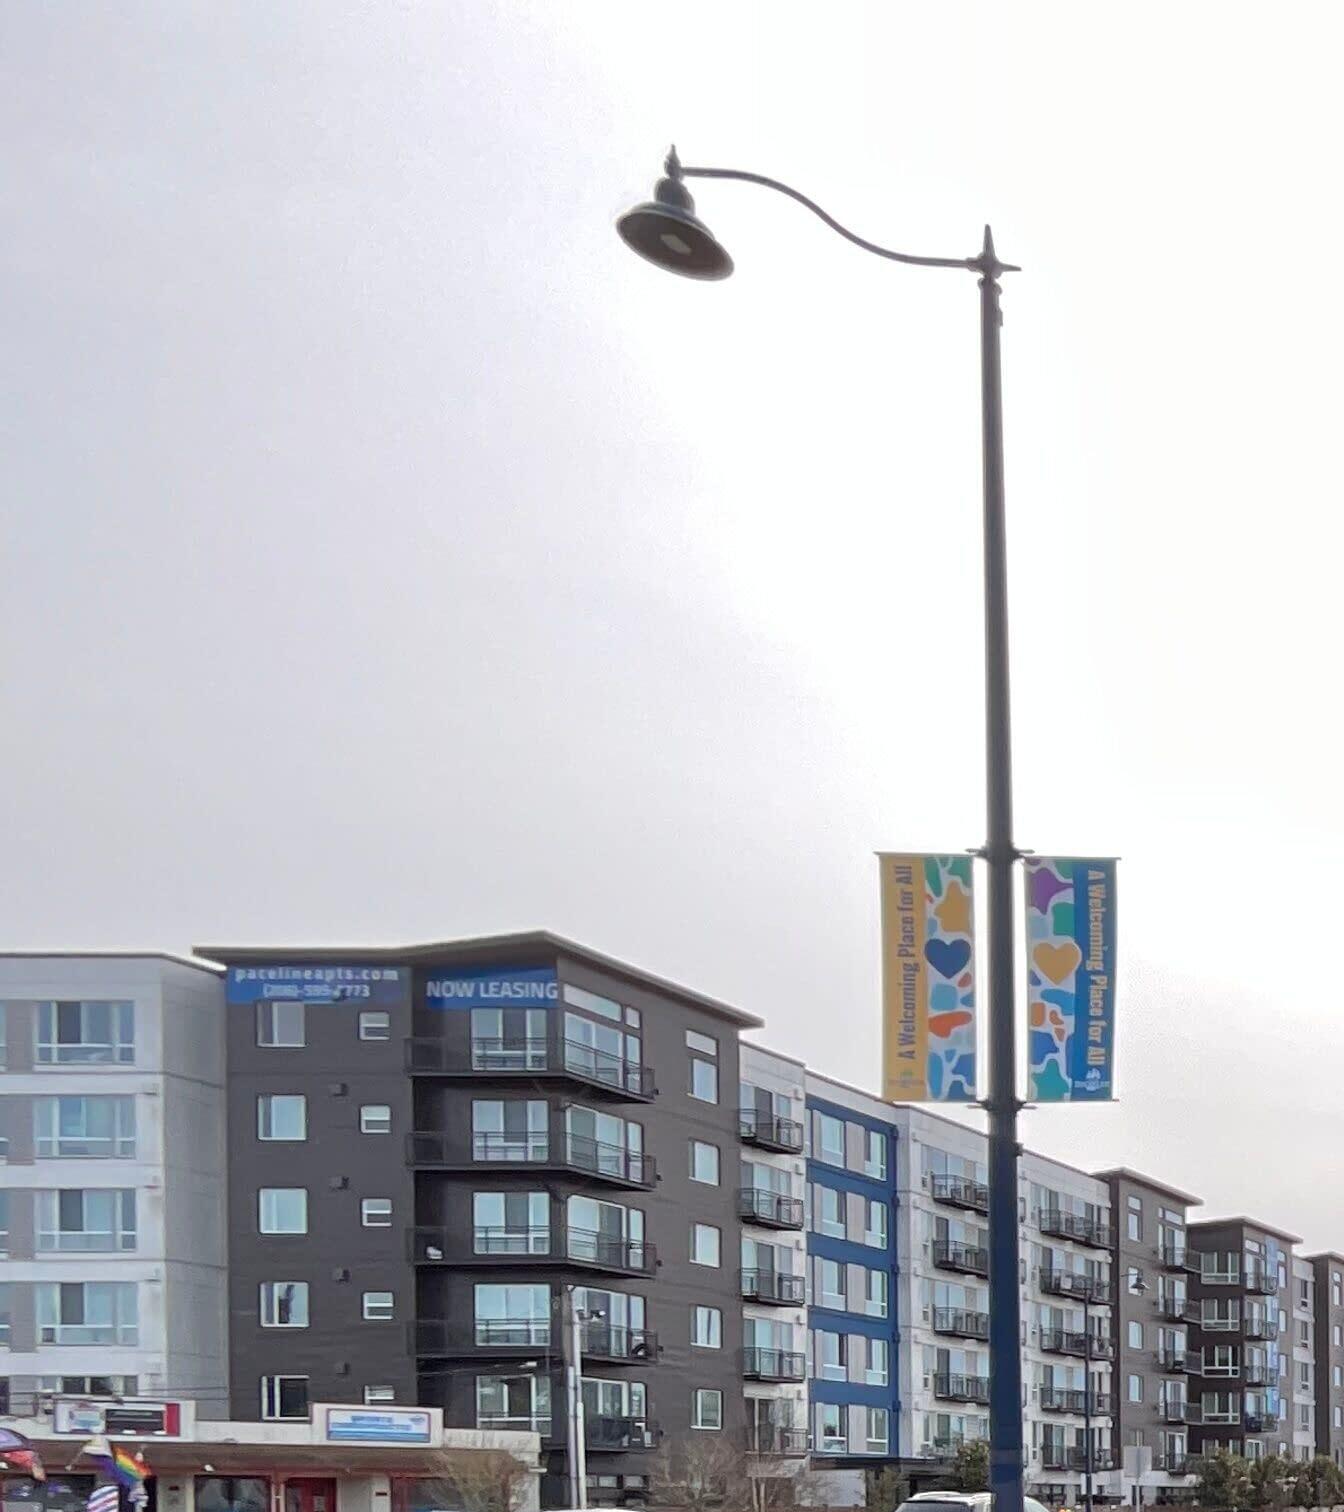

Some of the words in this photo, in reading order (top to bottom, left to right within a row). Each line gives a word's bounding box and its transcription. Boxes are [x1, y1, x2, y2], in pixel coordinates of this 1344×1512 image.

[893, 865, 912, 885] All
[1088, 869, 1106, 880] A
[896, 891, 915, 911] for
[897, 917, 916, 958] Place
[1086, 883, 1109, 972] Welcoming
[426, 980, 475, 998] NOW
[479, 981, 559, 999] LEASING
[1089, 975, 1108, 1016] Place
[897, 961, 920, 1046] Welcoming
[1088, 1019, 1108, 1043] for
[1087, 1045, 1105, 1066] All
